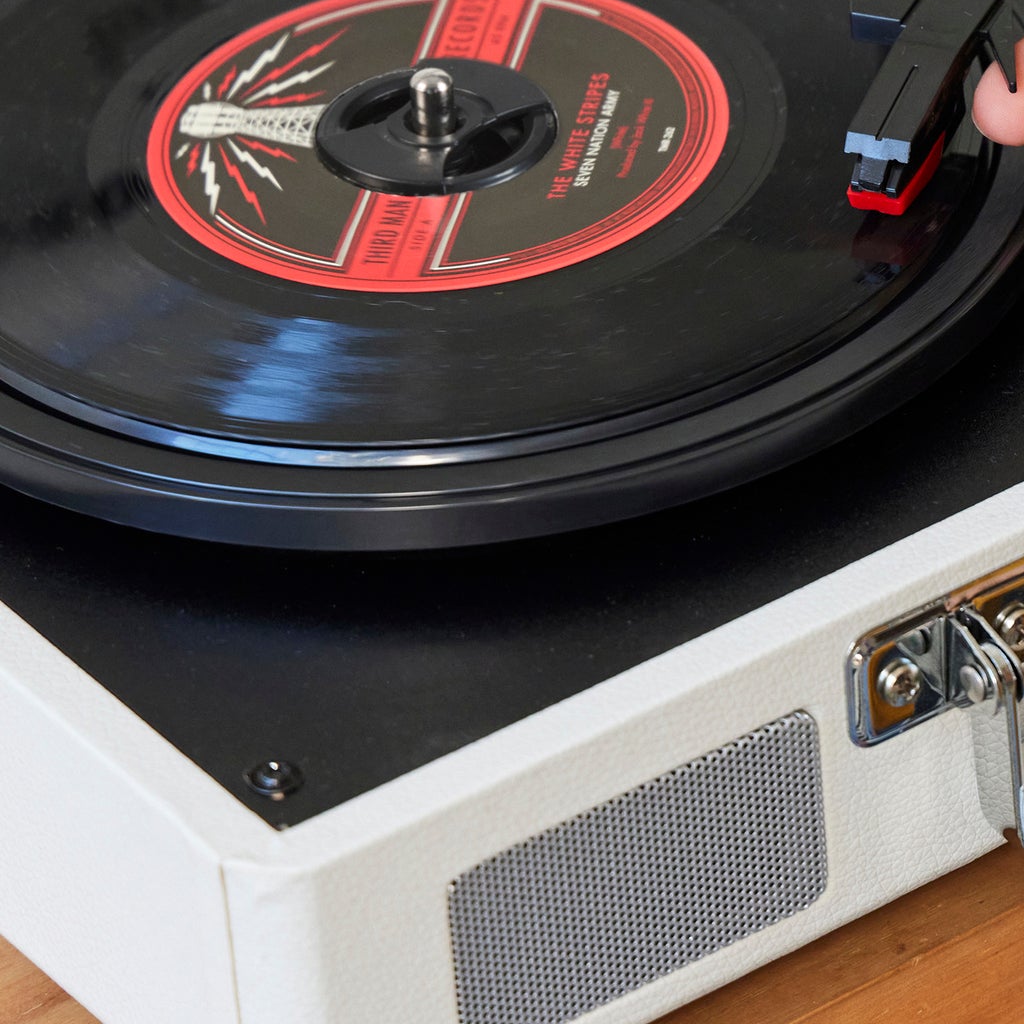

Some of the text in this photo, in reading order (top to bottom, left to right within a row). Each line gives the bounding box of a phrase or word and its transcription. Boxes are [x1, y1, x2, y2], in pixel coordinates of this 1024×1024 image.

[547, 72, 611, 200] THE WHITE STRIPES
[573, 89, 620, 187] SEVEN NATION ARMY
[360, 199, 413, 265] THIRD MAN
[408, 229, 430, 251] SIDE
